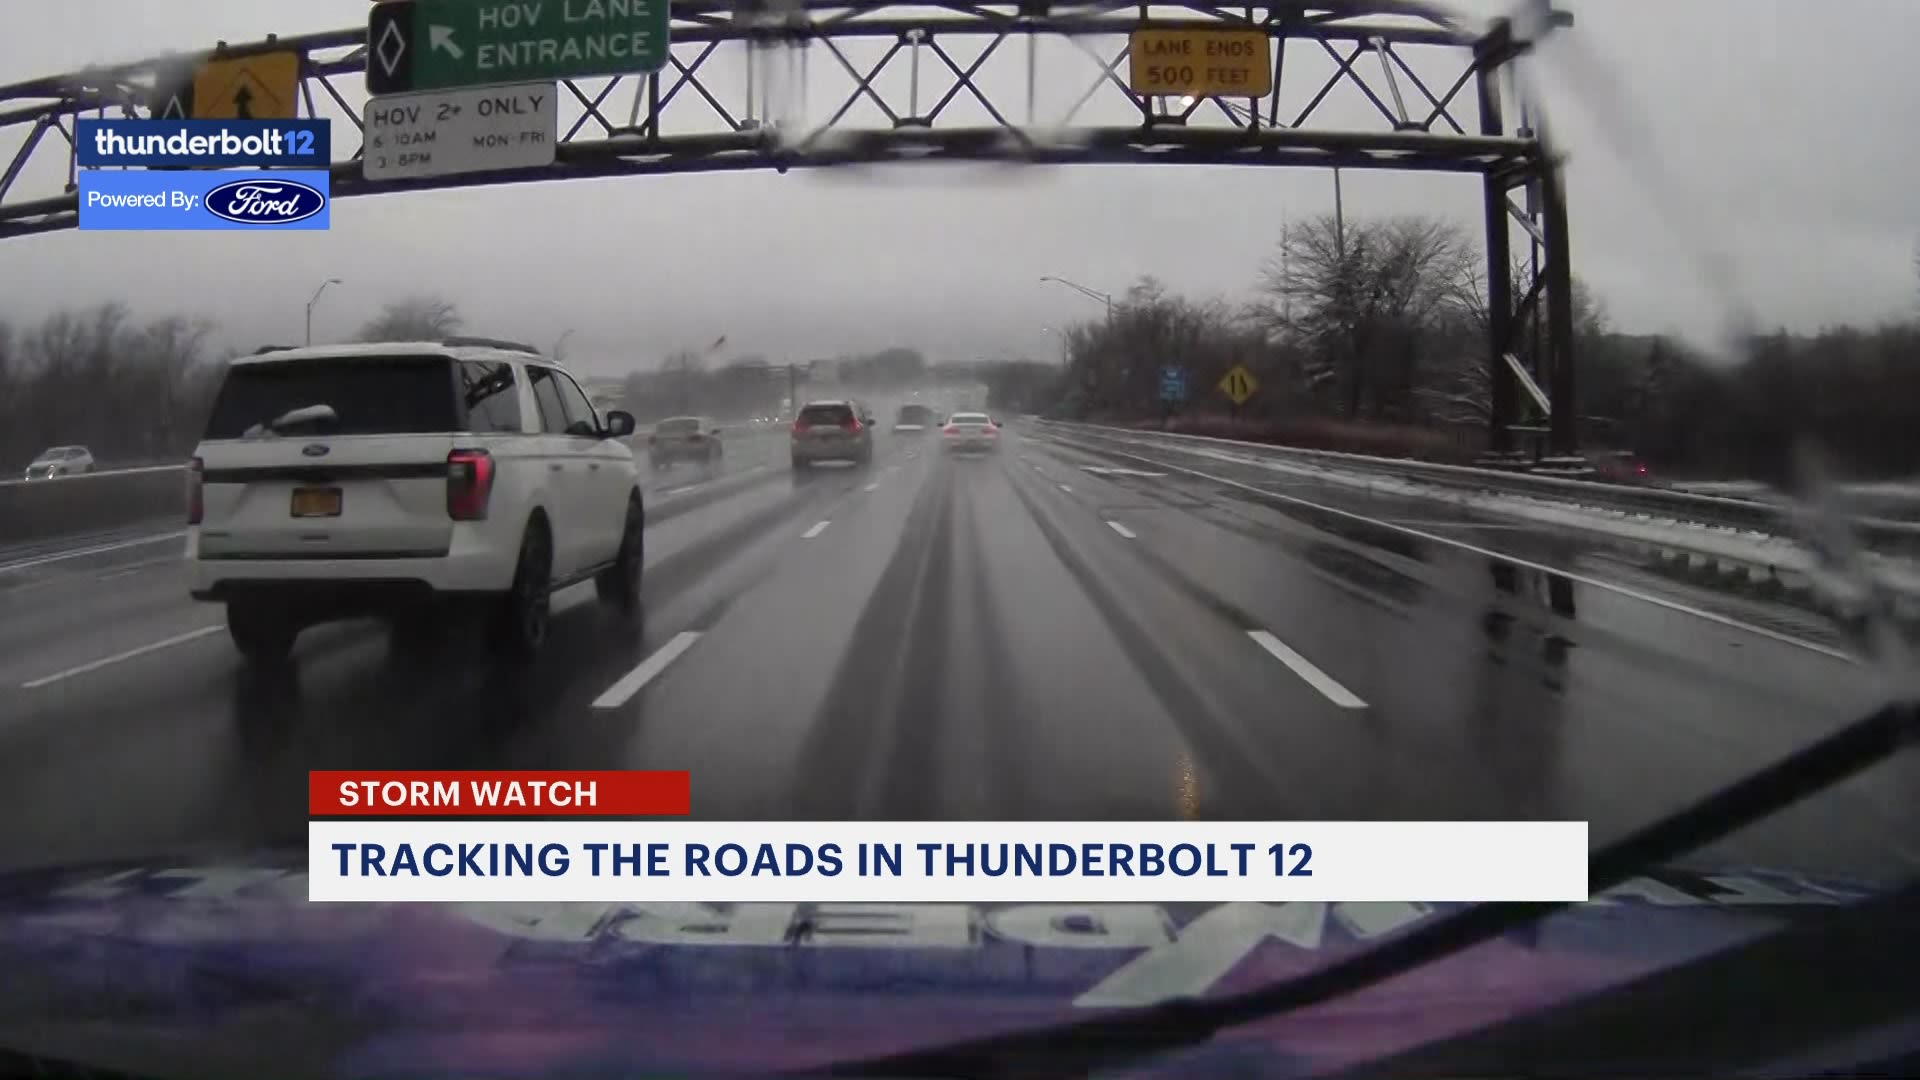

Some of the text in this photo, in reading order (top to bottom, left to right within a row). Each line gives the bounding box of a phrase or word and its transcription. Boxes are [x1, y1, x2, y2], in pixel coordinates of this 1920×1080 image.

[478, 0, 651, 29] HOV LANE
[476, 31, 651, 69] ENTRANCE
[1143, 39, 1255, 57] LANE ENDS
[1147, 65, 1250, 86] 500 FEET
[373, 105, 421, 128] HOV
[478, 95, 543, 117] ONLY
